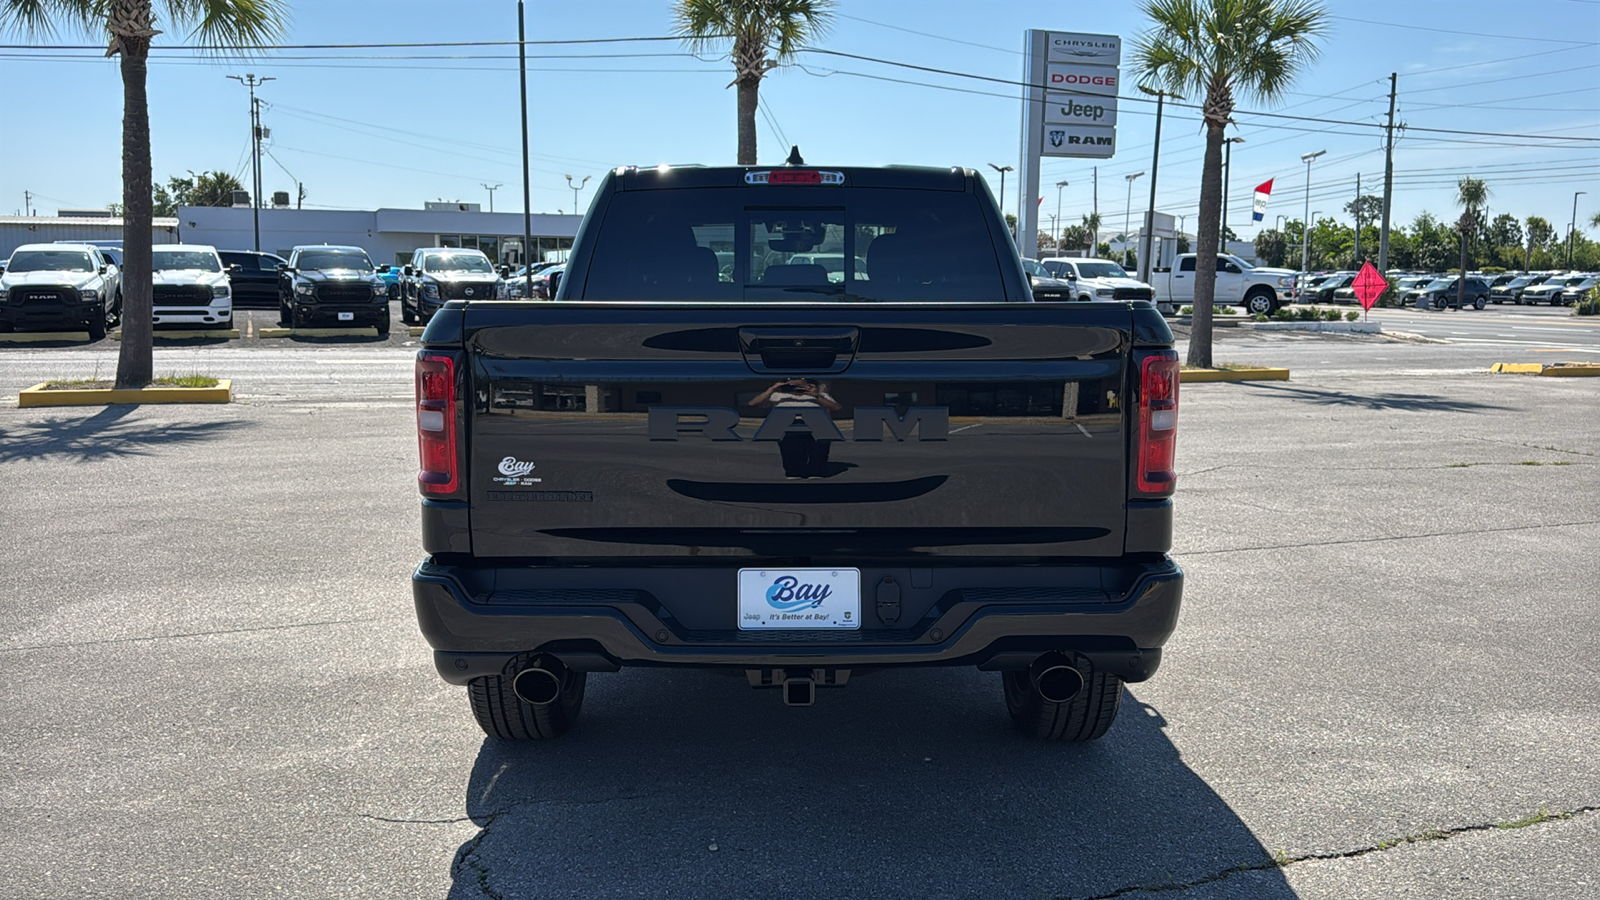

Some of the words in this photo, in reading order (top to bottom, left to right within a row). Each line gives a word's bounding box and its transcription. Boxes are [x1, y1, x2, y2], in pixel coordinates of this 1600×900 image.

[1054, 39, 1116, 49] CHRYSLER
[1051, 74, 1116, 86] DODGE
[1060, 99, 1104, 121] Jeep
[1068, 135, 1112, 146] RAM
[648, 406, 949, 442] RAM
[498, 456, 536, 477] Bay
[770, 575, 833, 608] Bay
[814, 613, 830, 621] Bay!
